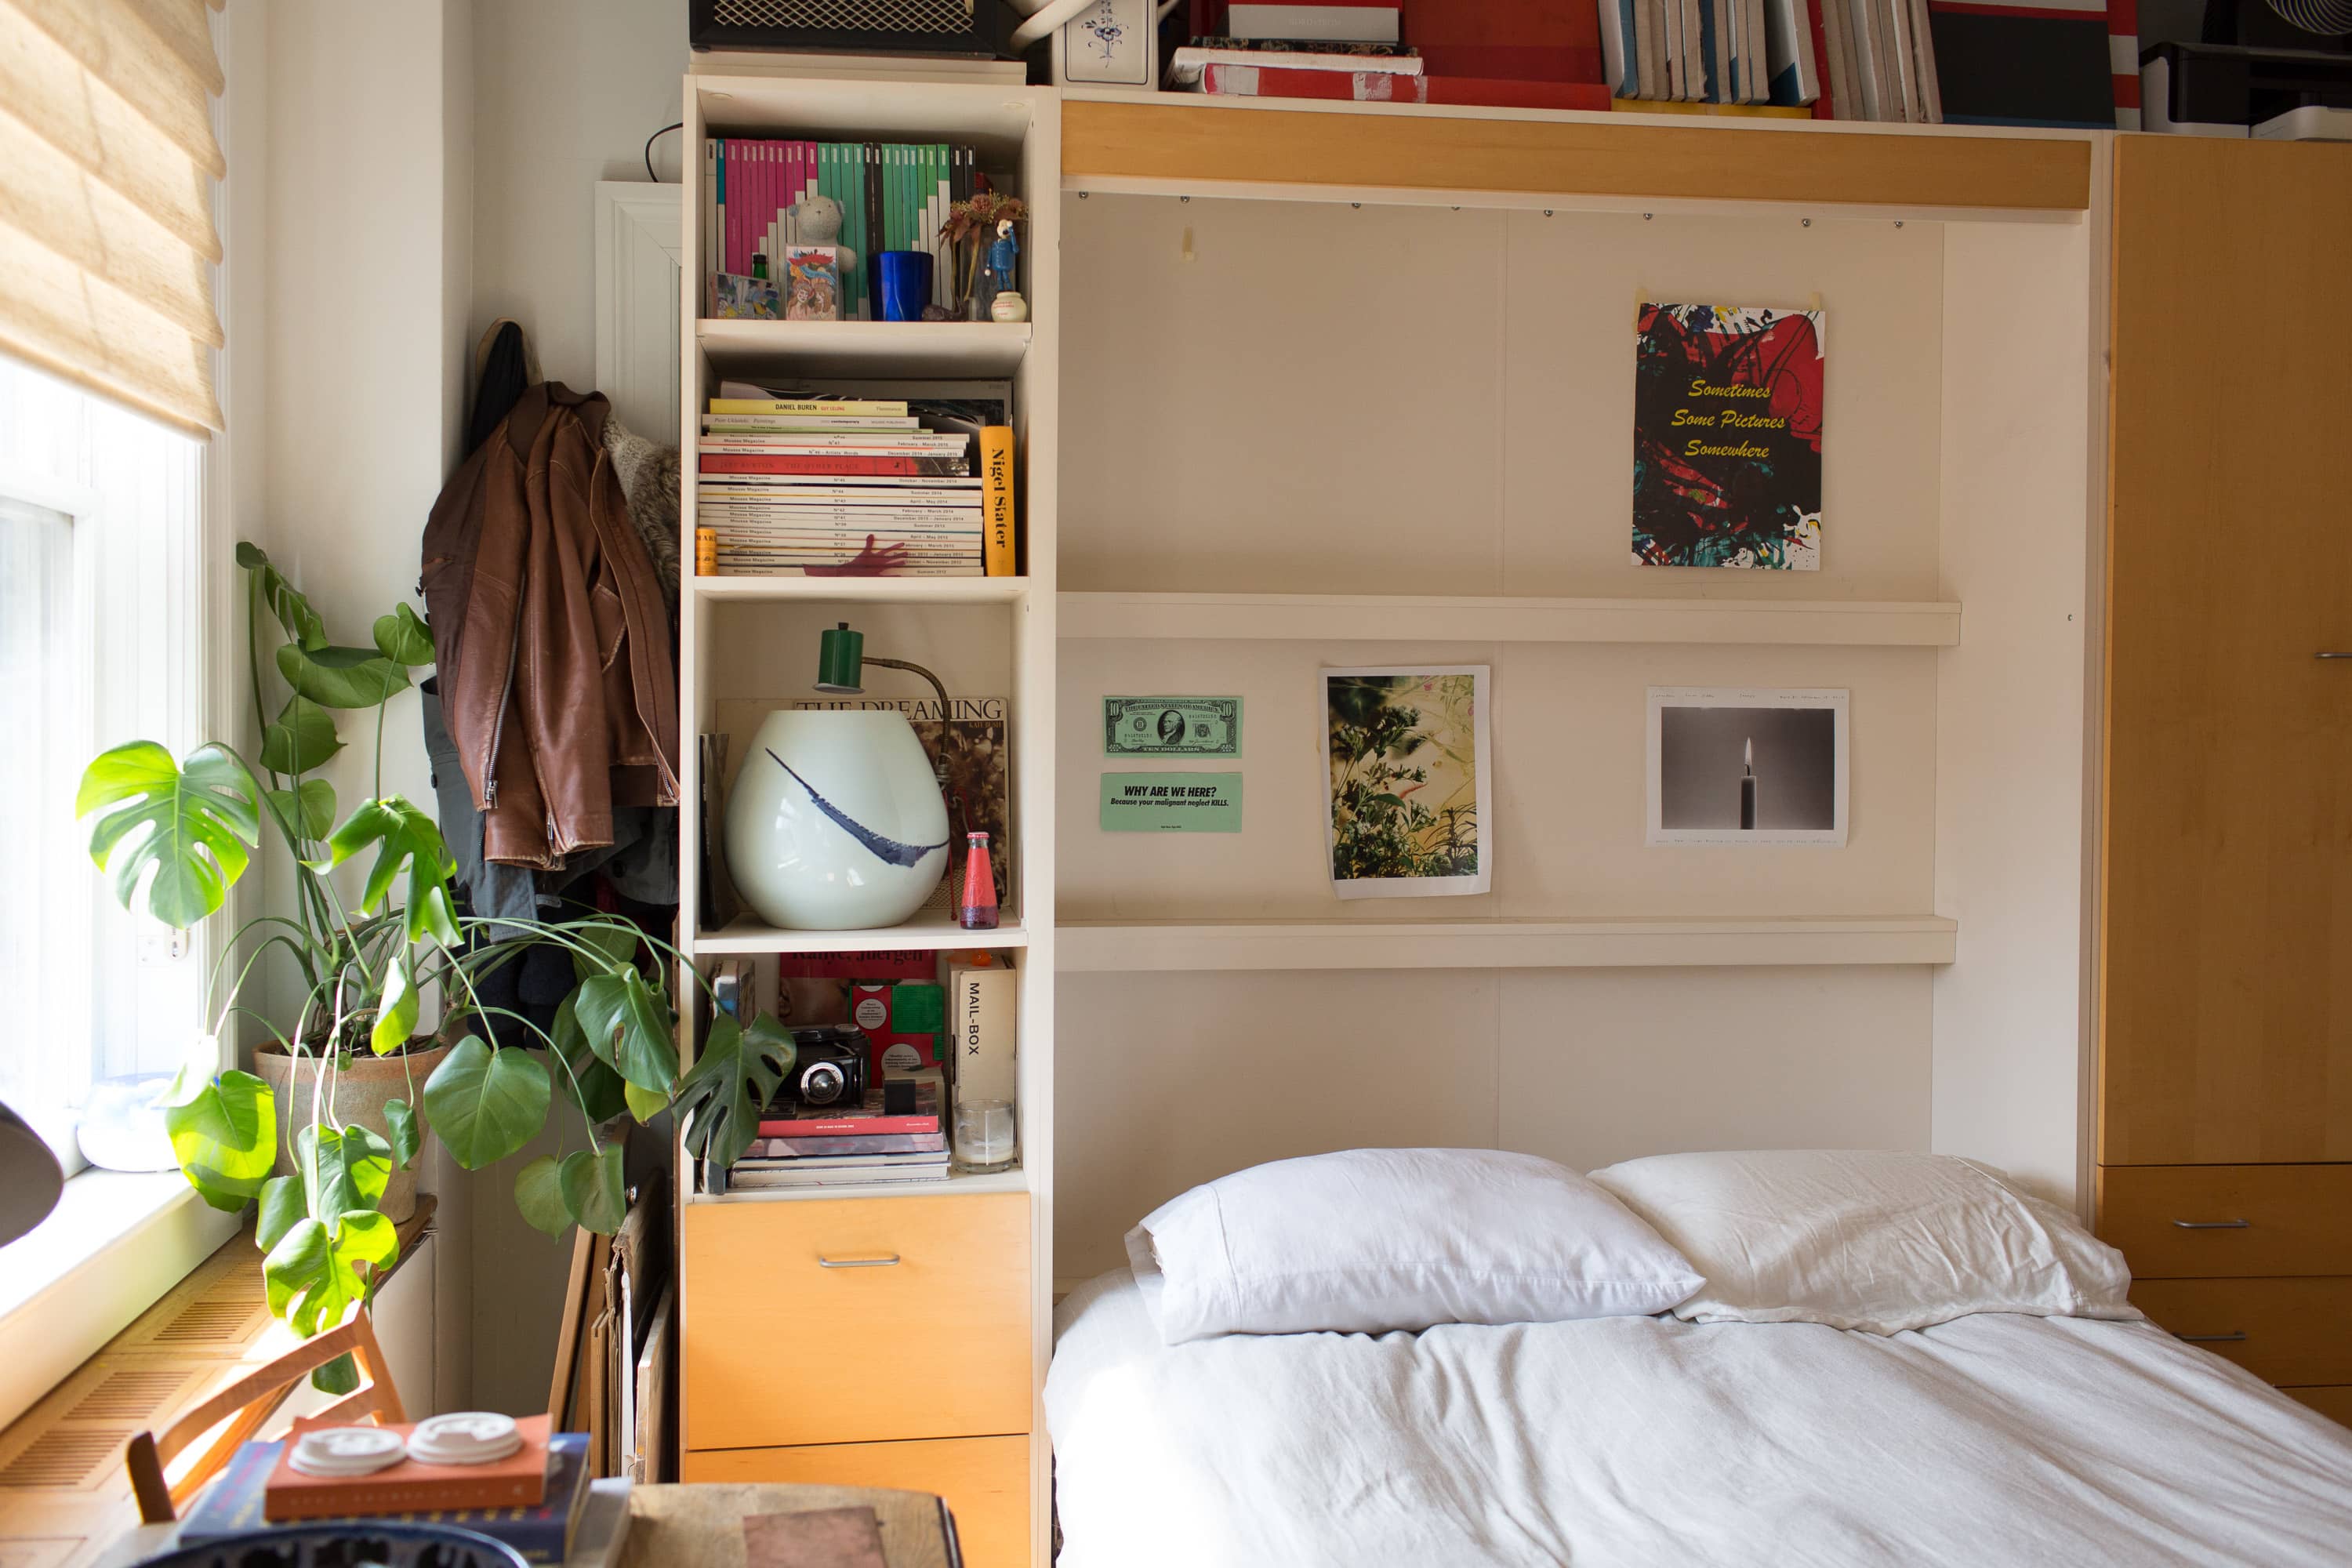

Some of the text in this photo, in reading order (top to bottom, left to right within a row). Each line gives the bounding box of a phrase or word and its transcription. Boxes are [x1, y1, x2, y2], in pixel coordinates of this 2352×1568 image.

[1688, 379, 1771, 399] Sometimes
[1671, 408, 1786, 429] Some Pictures
[1685, 439, 1769, 458] Somewhere
[989, 448, 1007, 548] Nigel Slater
[1110, 702, 1120, 716] 10
[1223, 702, 1232, 717] 10
[1124, 786, 1217, 797] WHY ARE WE HERE?
[1155, 798, 1186, 807] malignant
[968, 982, 980, 1056] MAIL-BOX
